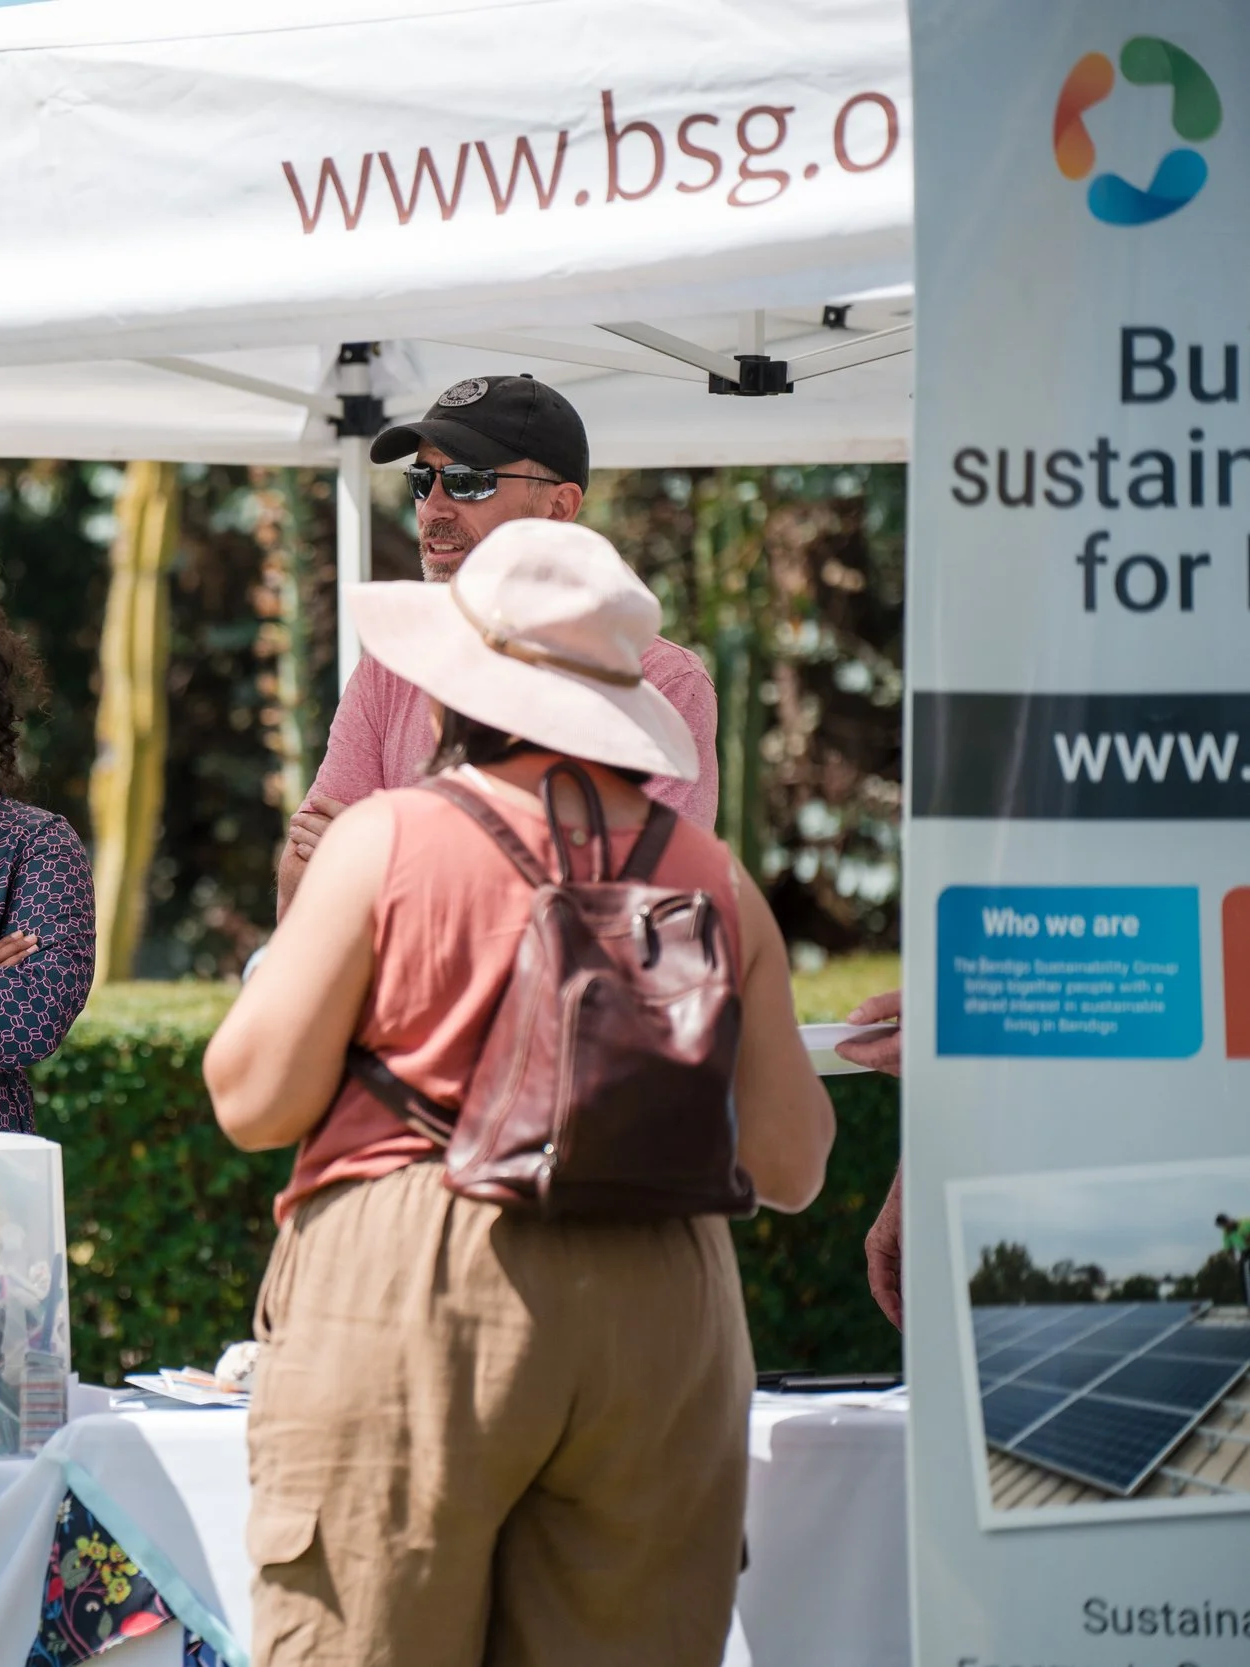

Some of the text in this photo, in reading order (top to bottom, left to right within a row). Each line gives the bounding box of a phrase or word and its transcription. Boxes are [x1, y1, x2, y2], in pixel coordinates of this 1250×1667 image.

[281, 88, 899, 236] www.bsg.o
[1075, 530, 1212, 614] for
[982, 906, 1140, 938] Who we are
